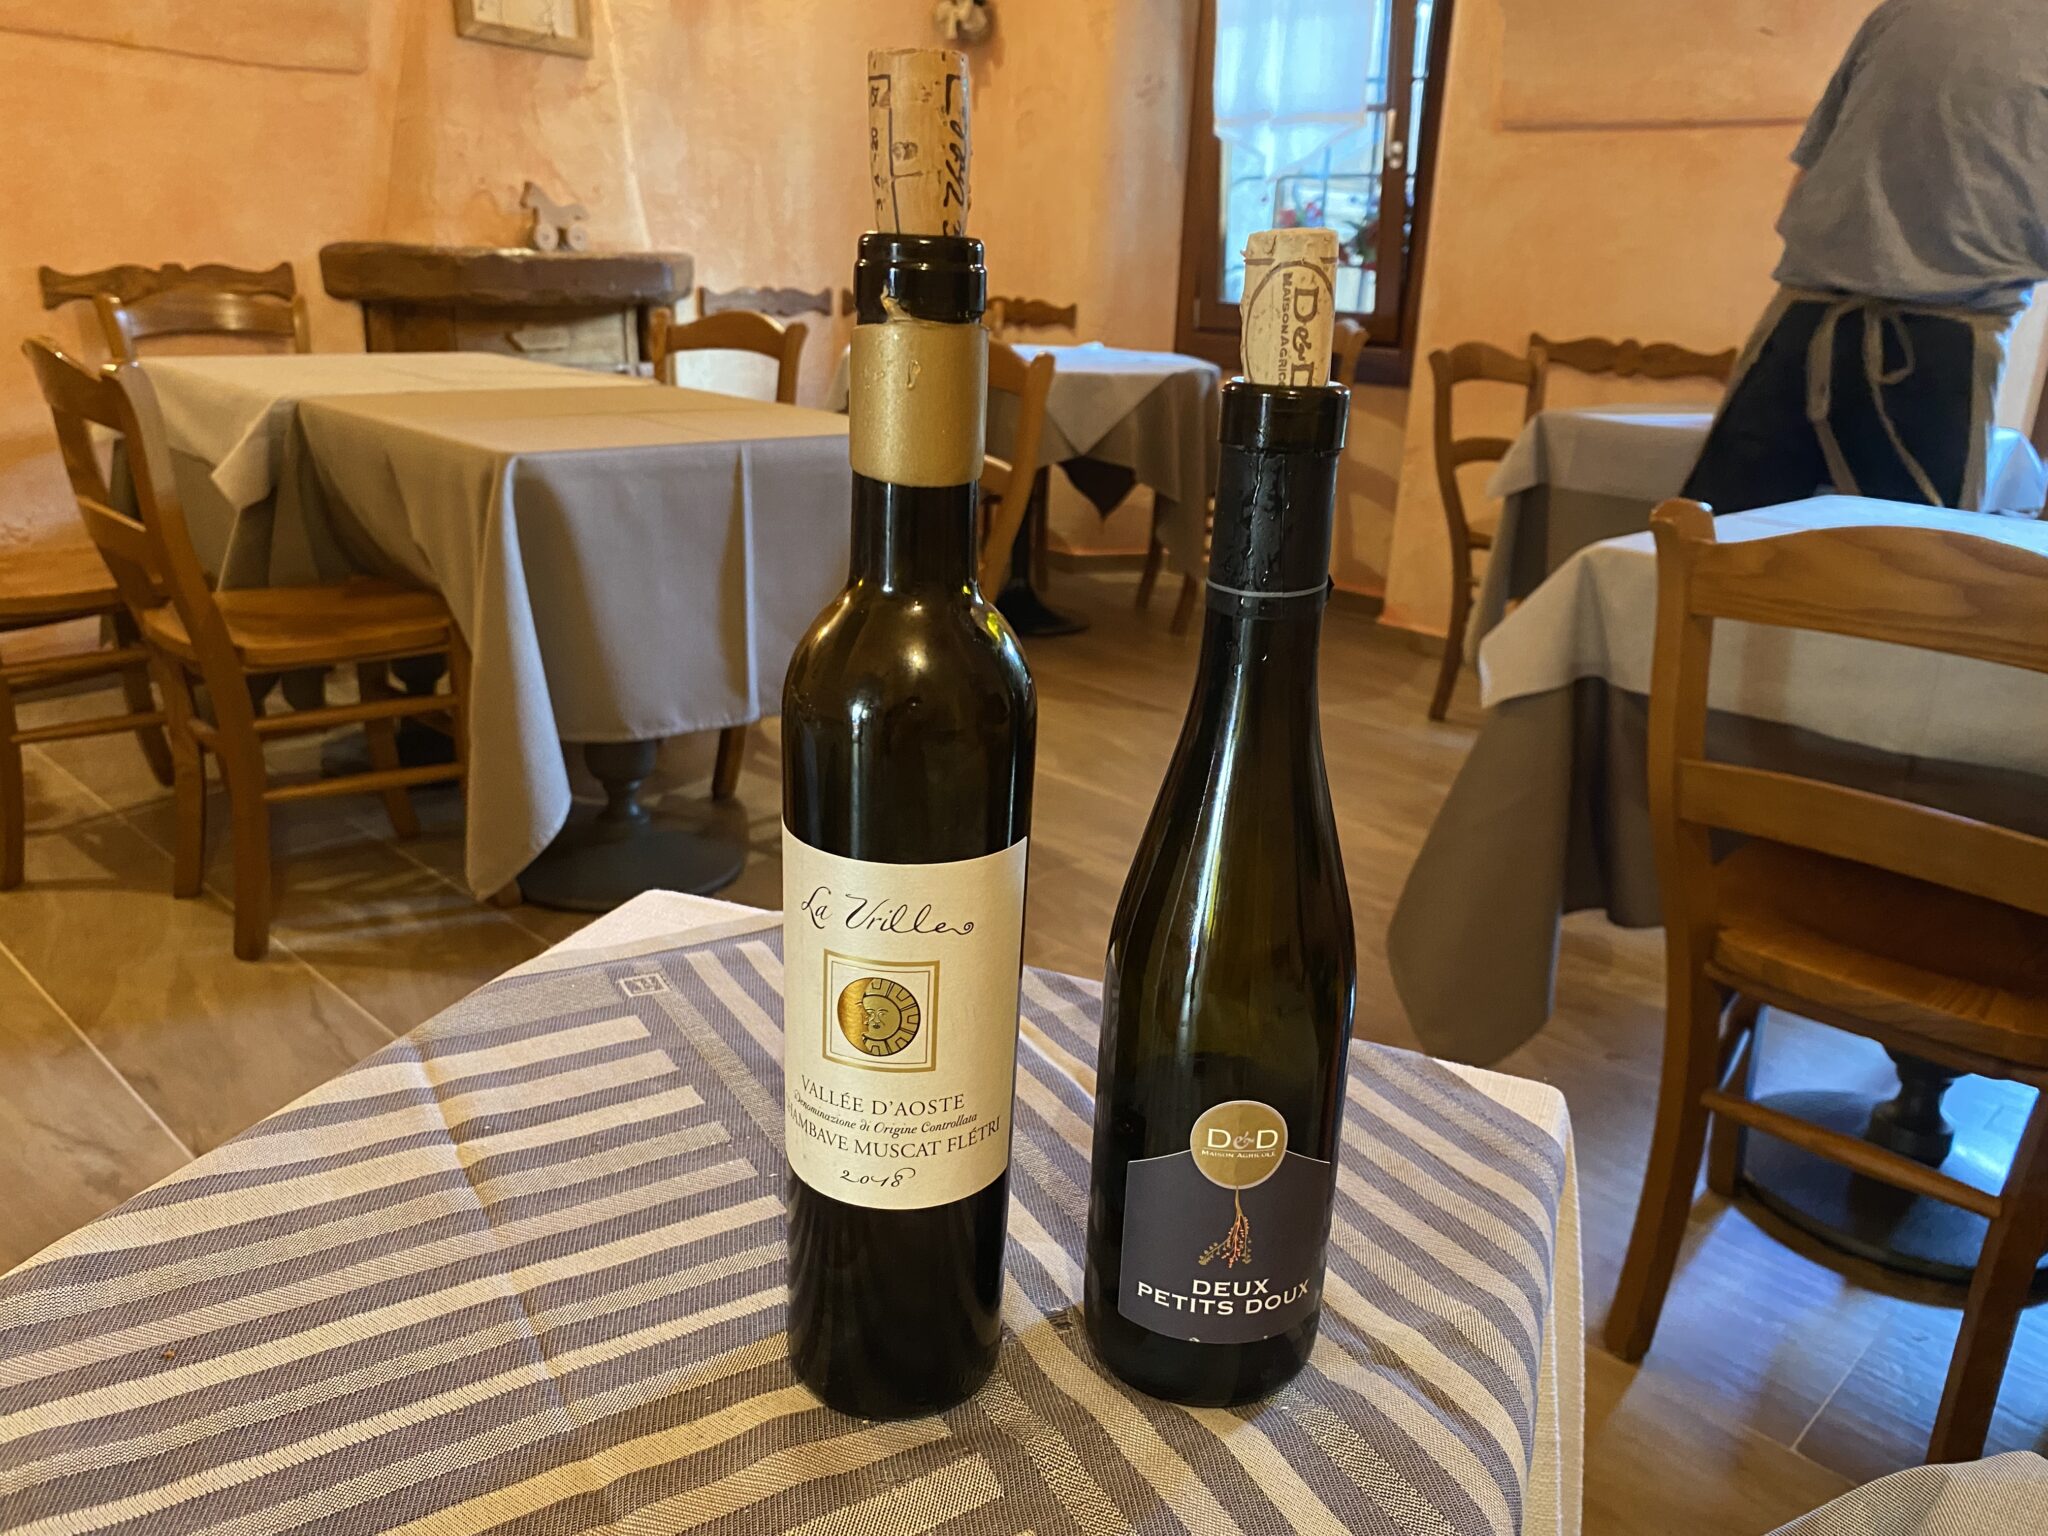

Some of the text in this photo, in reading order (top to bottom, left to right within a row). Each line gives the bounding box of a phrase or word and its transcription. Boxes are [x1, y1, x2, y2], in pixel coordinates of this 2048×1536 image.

[801, 886, 975, 935] La Vrille
[801, 1074, 864, 1113] VALLÉE
[793, 1088, 978, 1139] Denominazione di Origine Controllata
[854, 1139, 942, 1159] MUSCAT
[947, 1115, 1001, 1153] FLÉTRI
[1207, 1128, 1279, 1149] D&D
[840, 1167, 917, 1188] 2018
[1137, 1279, 1310, 1316] PETITS DOUX
[1192, 1278, 1270, 1297] DEUX
